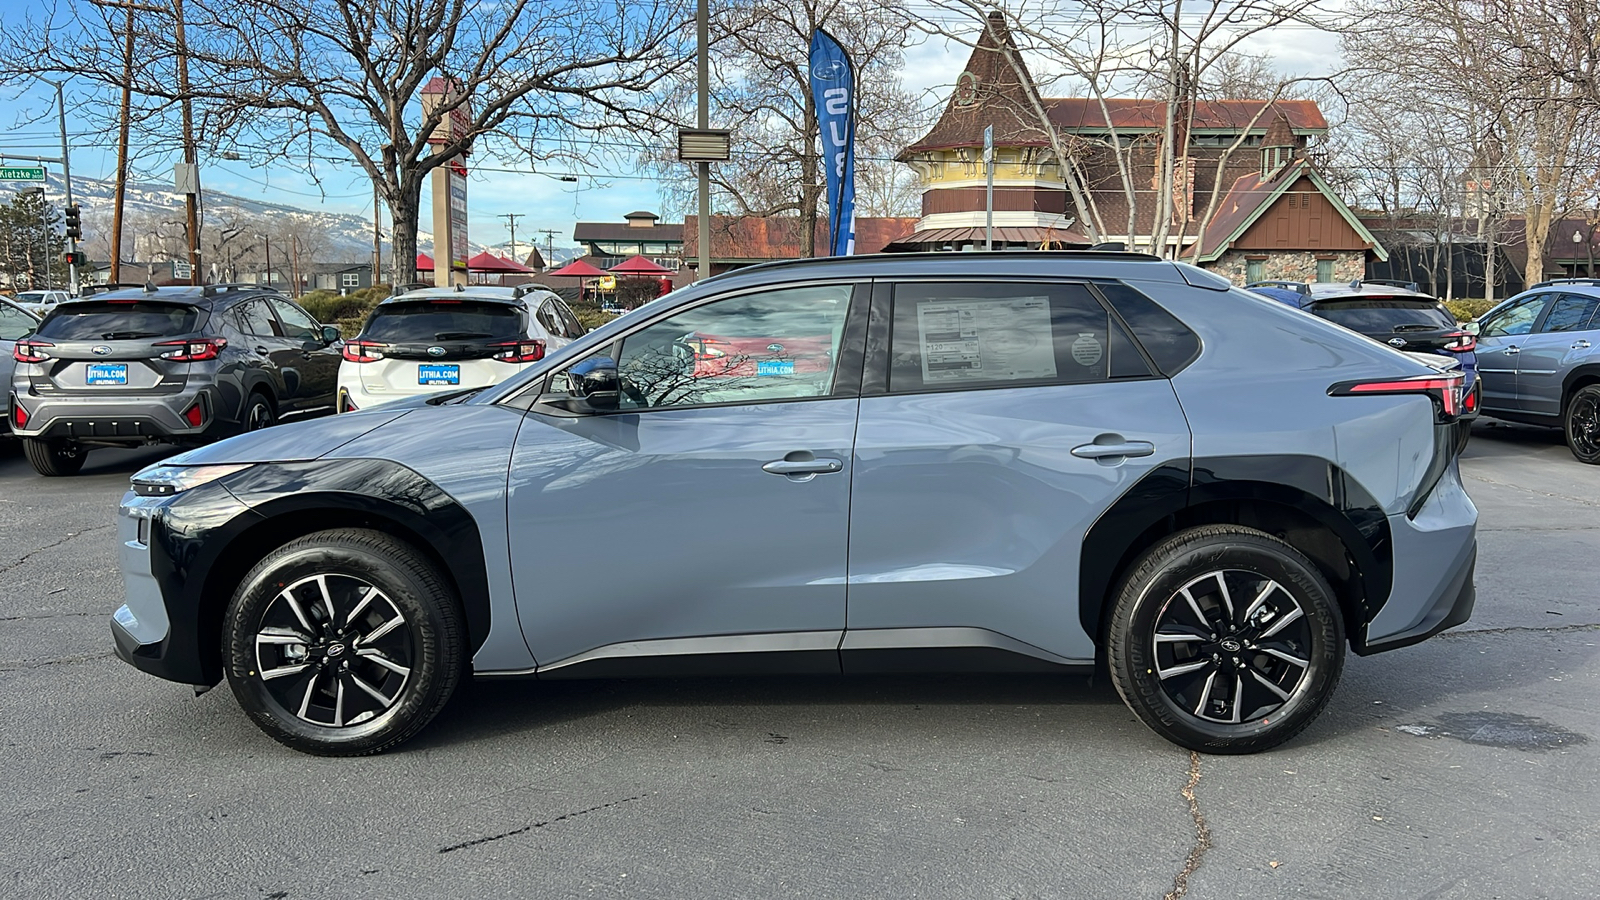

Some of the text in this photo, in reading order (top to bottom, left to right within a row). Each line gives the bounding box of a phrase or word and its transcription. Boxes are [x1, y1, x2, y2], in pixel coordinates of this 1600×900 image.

[0, 170, 30, 178] Kietzke
[88, 370, 126, 378] LITHIA.COM
[420, 370, 458, 378] LITHIA.COM
[758, 366, 794, 374] LITHIA.COM
